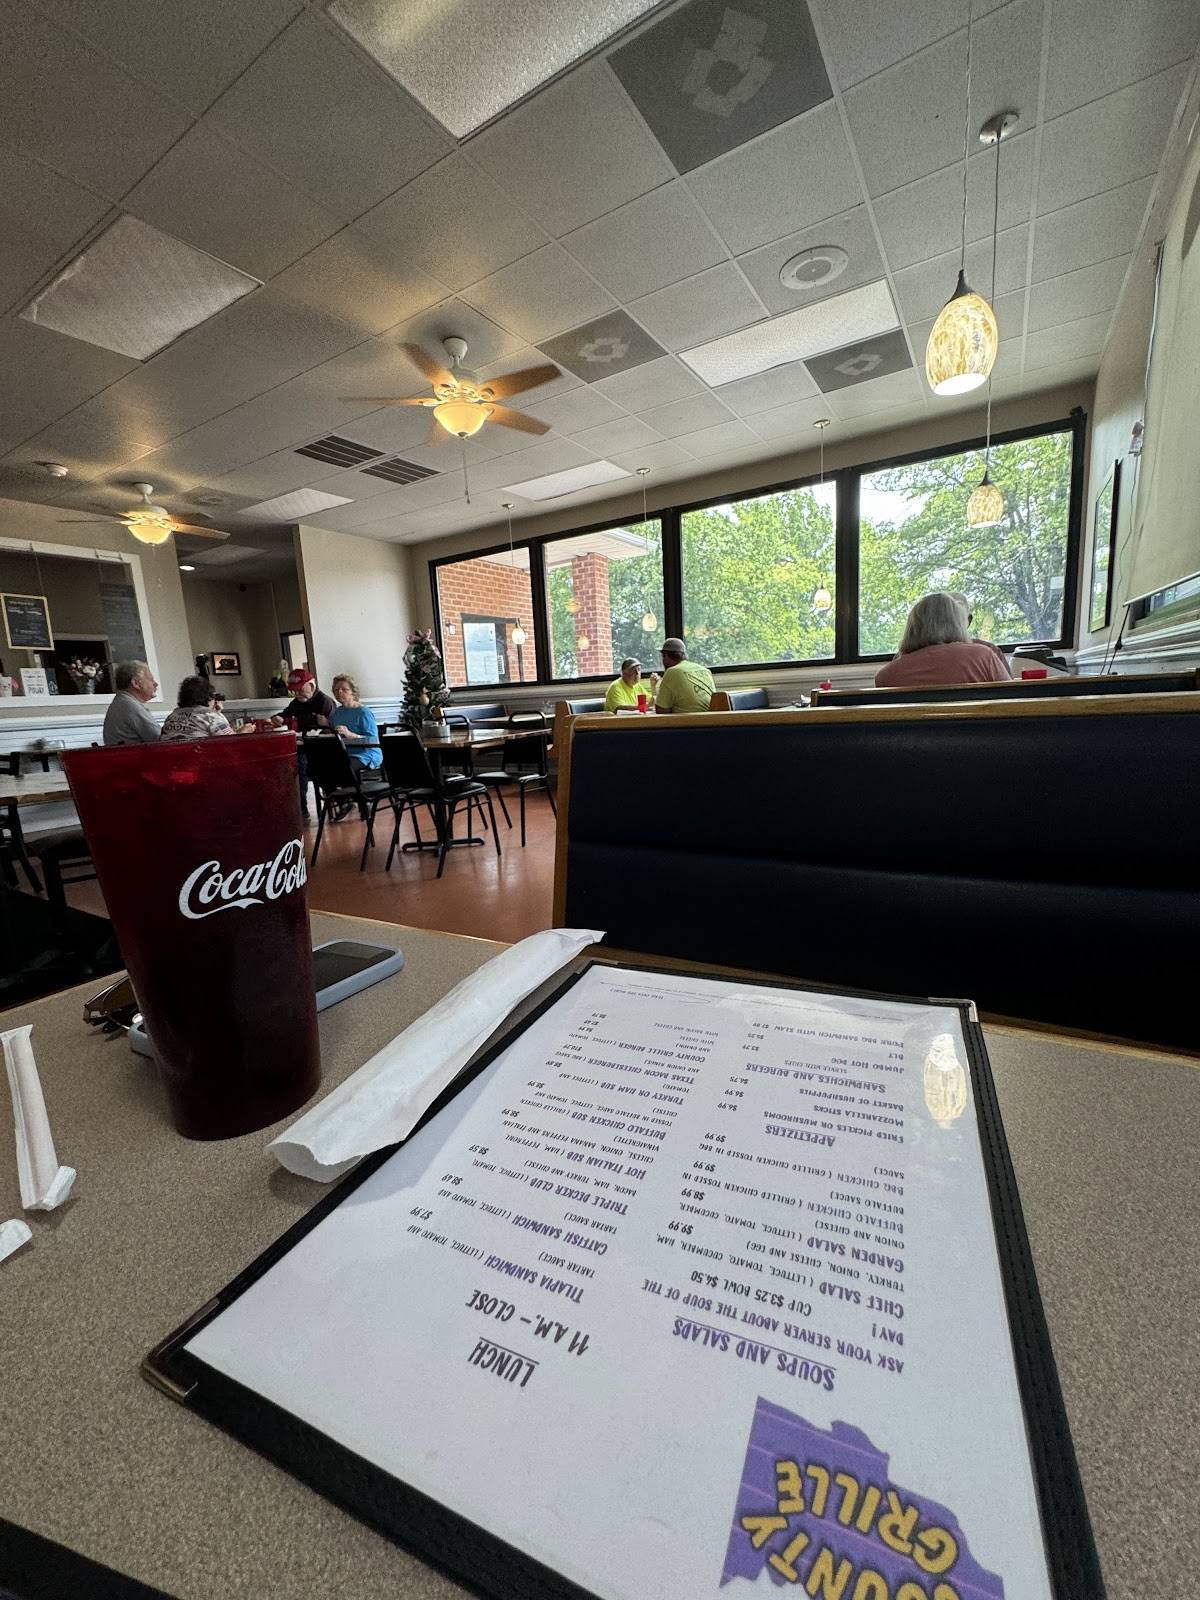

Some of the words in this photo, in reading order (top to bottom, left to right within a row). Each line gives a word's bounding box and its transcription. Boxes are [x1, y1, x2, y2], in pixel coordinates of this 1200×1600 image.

[818, 1031, 859, 1042] SANDWICH
[617, 1042, 647, 1052] BURGER
[647, 1047, 674, 1057] GRILLE
[587, 1057, 643, 1074] CHEESEBURGER
[674, 1052, 706, 1064] COUNTY
[643, 1069, 670, 1079] BACON
[745, 1062, 791, 1078] BURGERS
[792, 1070, 816, 1081] AND
[872, 1063, 905, 1075] JUMBO
[670, 1074, 695, 1085] TEXAS
[818, 1074, 886, 1094] SANDWICHES
[651, 1092, 684, 1106] TURKEY
[799, 1088, 856, 1103] HUSHPUPPIES
[813, 1104, 842, 1116] STICKS
[872, 1100, 904, 1112] BASKET
[502, 1120, 527, 1132] ITALIAN
[588, 1115, 626, 1130] CHICKEN
[763, 1110, 818, 1127] MUSHROOMS
[844, 1109, 904, 1128] MOZZARELLA
[541, 1130, 570, 1143] PEPPERS
[626, 1124, 667, 1141] BUFFALO
[764, 1124, 836, 1148] APPETIZERS
[836, 1123, 873, 1137] PICKLES
[876, 1131, 904, 1144] FRIED
[570, 1137, 597, 1150] BANANA
[726, 1149, 753, 1162] TOSSED
[756, 1156, 790, 1169] CHICKEN
[585, 1156, 624, 1175] ITALIAN
[623, 1166, 647, 1181] HOT
[791, 1163, 826, 1177] GRILLED
[529, 1177, 554, 1192] CLUB
[565, 1171, 590, 1184] TURKEY
[693, 1175, 722, 1188] TOSSED
[837, 1172, 880, 1190] CHICKEN
[554, 1184, 591, 1204] DECKER
[724, 1182, 759, 1197] CHICKEN
[883, 1182, 904, 1197] BBQ
[451, 1193, 478, 1208] TOMATO
[591, 1195, 629, 1216] TRIPLE
[760, 1191, 796, 1206] GRILLED
[807, 1201, 852, 1220] CHICKEN
[864, 1199, 905, 1216] BUFFALO
[511, 1214, 563, 1240] SANDWICH
[590, 1220, 618, 1235] TARTAR
[855, 1213, 904, 1235] BUFFALO
[420, 1230, 449, 1246] TOMATO
[562, 1231, 608, 1256] CATFISH
[806, 1236, 846, 1257] SALAD
[874, 1234, 905, 1250] ONION
[483, 1254, 539, 1284] SANDWICH
[789, 1252, 822, 1269] CHEESE
[851, 1247, 905, 1274] GARDEN
[566, 1261, 596, 1279] TARTAR
[641, 1278, 663, 1296] THE
[690, 1270, 719, 1289] $4.50
[723, 1278, 751, 1298] BOWL
[539, 1274, 584, 1304] TILAPIA
[818, 1281, 862, 1305] SALAD
[465, 1289, 516, 1323] CLOSE
[682, 1292, 713, 1312] SOUP
[754, 1288, 785, 1308] $3.25
[715, 1301, 738, 1320] THE
[787, 1299, 812, 1317] CUP
[866, 1295, 905, 1320] CHEF
[740, 1310, 780, 1332] ABOUT
[672, 1316, 731, 1352] SALADS
[783, 1322, 832, 1350] SERVER
[567, 1330, 590, 1357] 11
[836, 1339, 873, 1365] YOUR
[735, 1340, 771, 1365] AND
[467, 1338, 536, 1388] LUNCH
[776, 1351, 836, 1392] SOUPS
[877, 1353, 905, 1374] ASK
[775, 1460, 958, 1574] GRILLE
